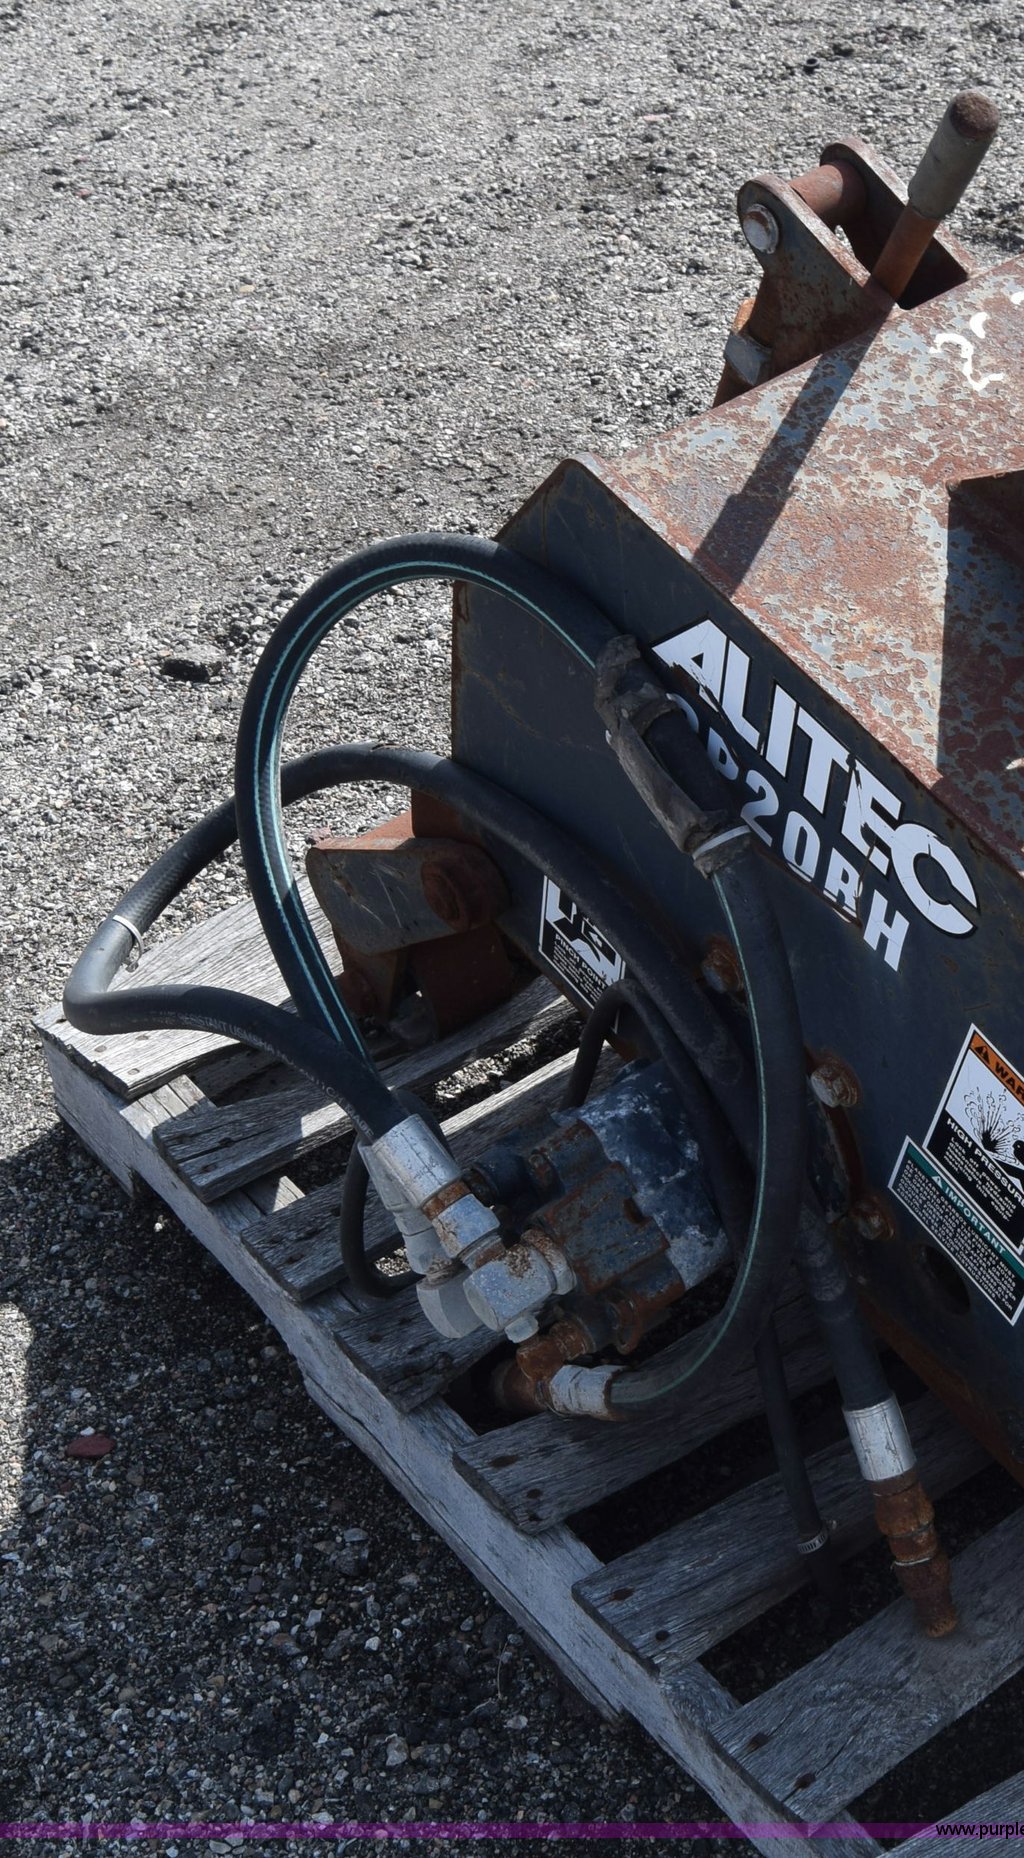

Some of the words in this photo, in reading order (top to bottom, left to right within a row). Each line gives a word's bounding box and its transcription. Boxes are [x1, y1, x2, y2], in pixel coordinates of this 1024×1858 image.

[652, 619, 978, 935] ALITEC
[555, 932, 579, 963] PINCH
[946, 1117, 972, 1148] HIGH
[950, 1135, 966, 1155] Lock
[981, 1169, 1001, 1193] power
[907, 1158, 939, 1196] PLANETARY
[967, 1225, 998, 1261] LUBRICANT
[944, 1185, 1005, 1256] IMPORTANT
